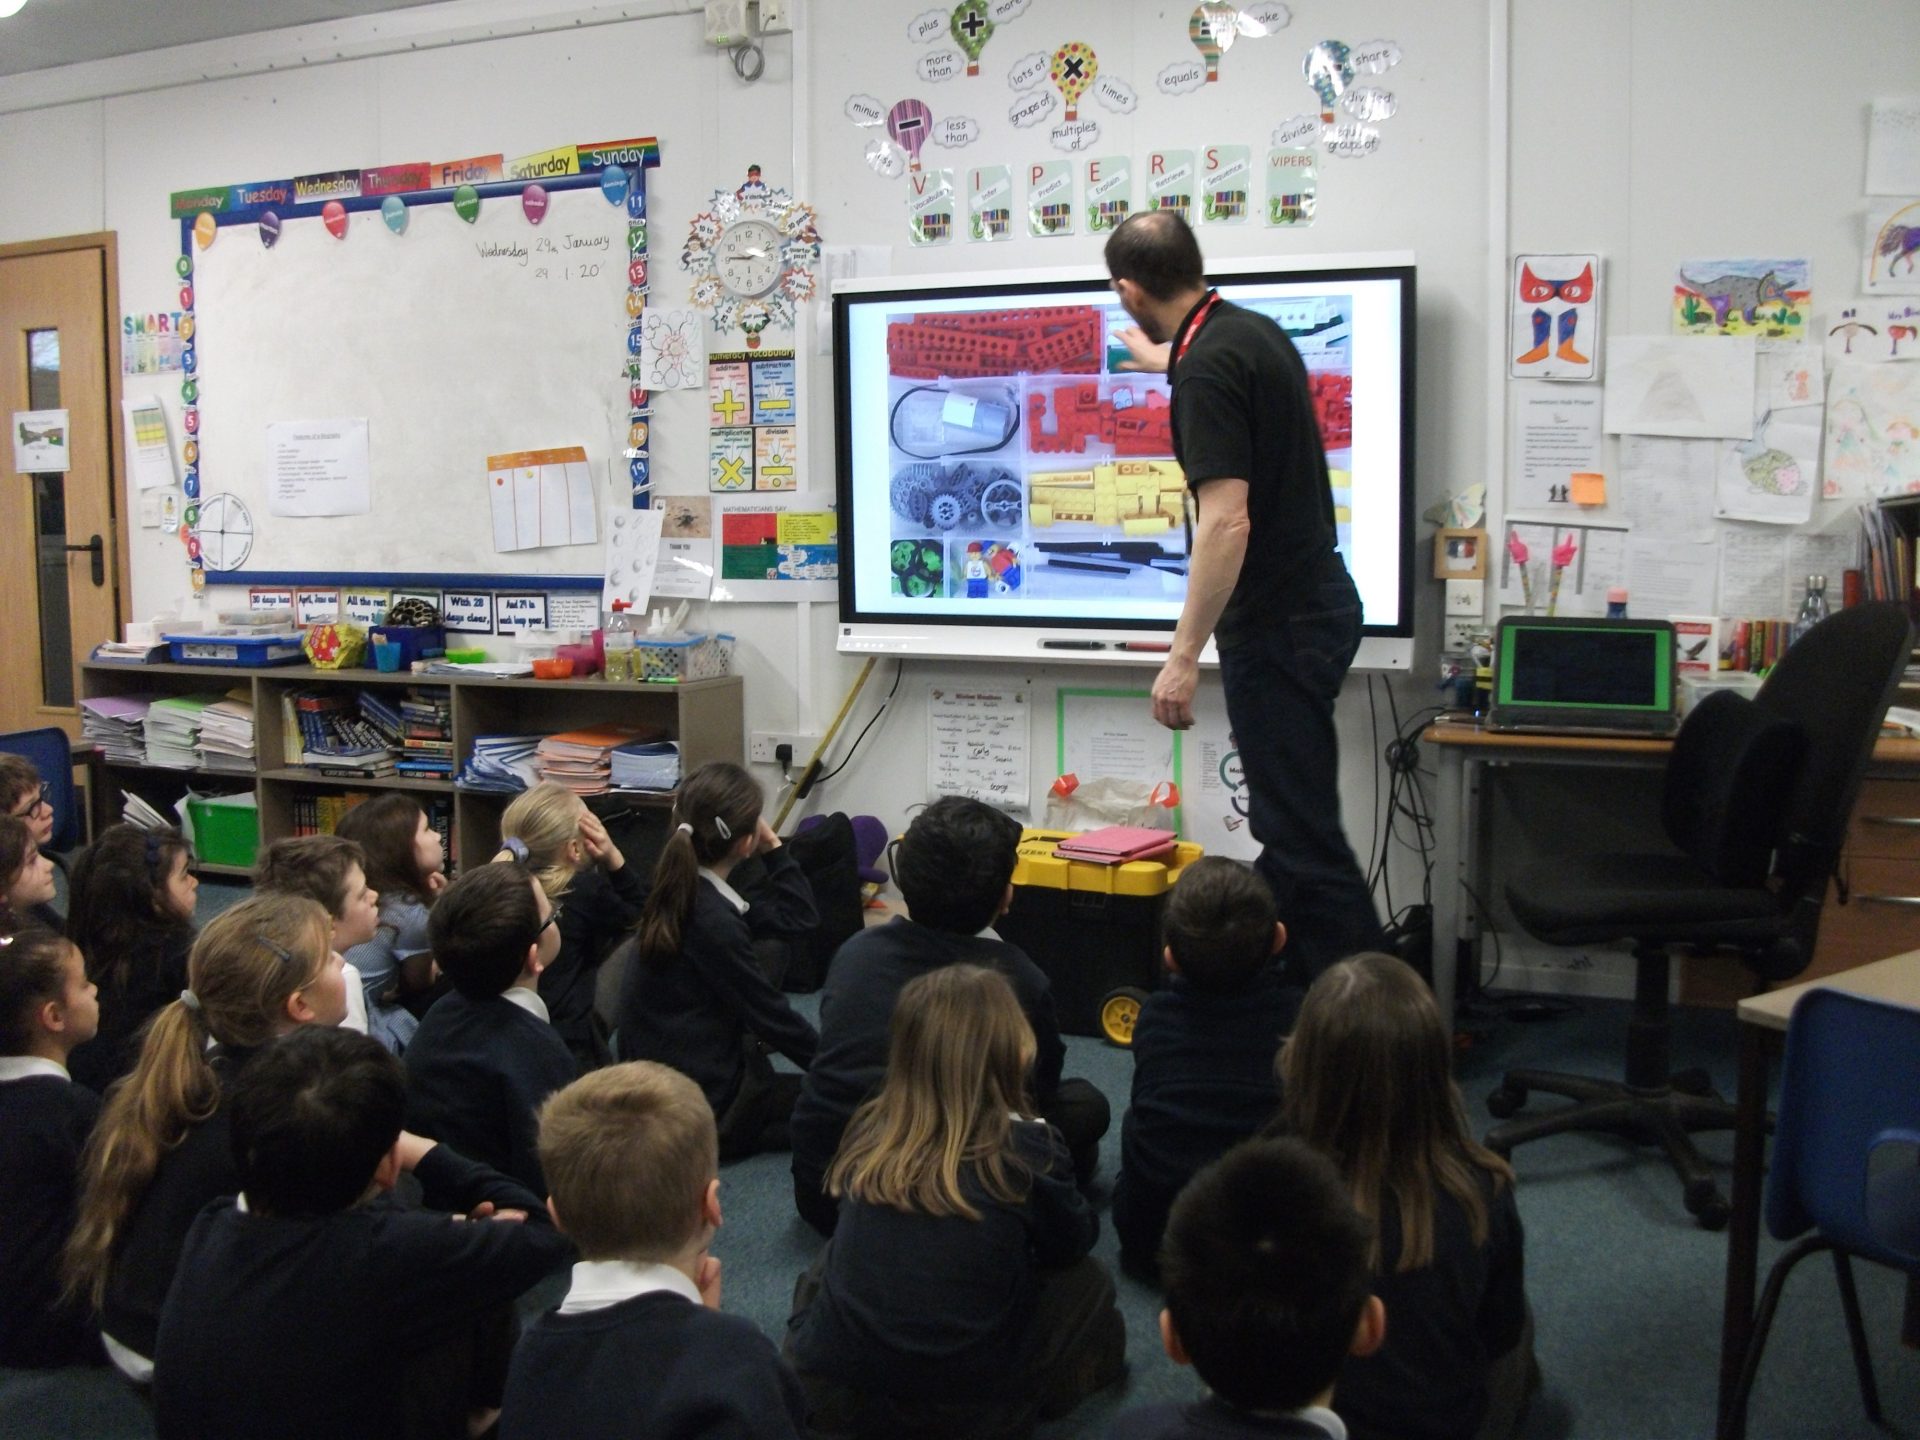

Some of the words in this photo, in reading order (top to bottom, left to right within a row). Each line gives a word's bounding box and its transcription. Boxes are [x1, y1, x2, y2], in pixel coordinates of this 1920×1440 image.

[918, 19, 939, 36] plus
[926, 54, 952, 66] more
[1355, 49, 1390, 66] share
[928, 66, 953, 77] than
[1012, 67, 1034, 86] lots
[1031, 58, 1046, 74] of
[1164, 69, 1199, 87] equals
[1101, 83, 1129, 105] times
[852, 102, 880, 119] minus
[1011, 99, 1039, 125] groups
[1036, 93, 1051, 109] of
[945, 120, 967, 131] less
[1052, 122, 1097, 138] multiples
[1280, 122, 1314, 144] divide
[944, 132, 969, 143] than
[1071, 138, 1082, 149] of
[592, 146, 645, 167] Sunday
[1151, 154, 1165, 174] R
[1206, 149, 1219, 170] S
[1271, 155, 1313, 168] VIPERS
[442, 164, 489, 185] Friday
[510, 155, 571, 181] Saturday
[1032, 166, 1044, 186] P
[1090, 162, 1100, 182] E
[1207, 163, 1244, 186] Sequence
[295, 177, 359, 198] Wednesday
[368, 171, 424, 189] Thursday
[913, 175, 927, 195] V
[1095, 176, 1120, 195] Explain
[1155, 169, 1186, 189] Retrieve
[236, 187, 288, 205] Tuesday
[981, 187, 998, 201] Infer
[1037, 180, 1063, 197] Predict
[176, 195, 225, 209] Monday
[629, 195, 643, 208] 11
[631, 230, 645, 244] 12
[476, 242, 529, 267] Wednesday
[563, 234, 610, 251] January
[535, 267, 549, 279] 29
[580, 264, 600, 278] 20
[630, 266, 645, 280] 13
[628, 297, 643, 310] 14
[124, 312, 181, 335] SMART
[755, 362, 791, 370] subtraction
[631, 428, 645, 441] 18
[631, 461, 646, 477] 19
[262, 595, 277, 607] days
[346, 595, 359, 606] All
[359, 595, 372, 606] the
[372, 598, 388, 607] rest
[450, 596, 472, 607] With
[473, 597, 485, 608] 28
[506, 599, 519, 609] And
[446, 611, 465, 625] days
[467, 612, 491, 625] clear,
[513, 615, 527, 628] leap
[528, 616, 545, 628] year.
